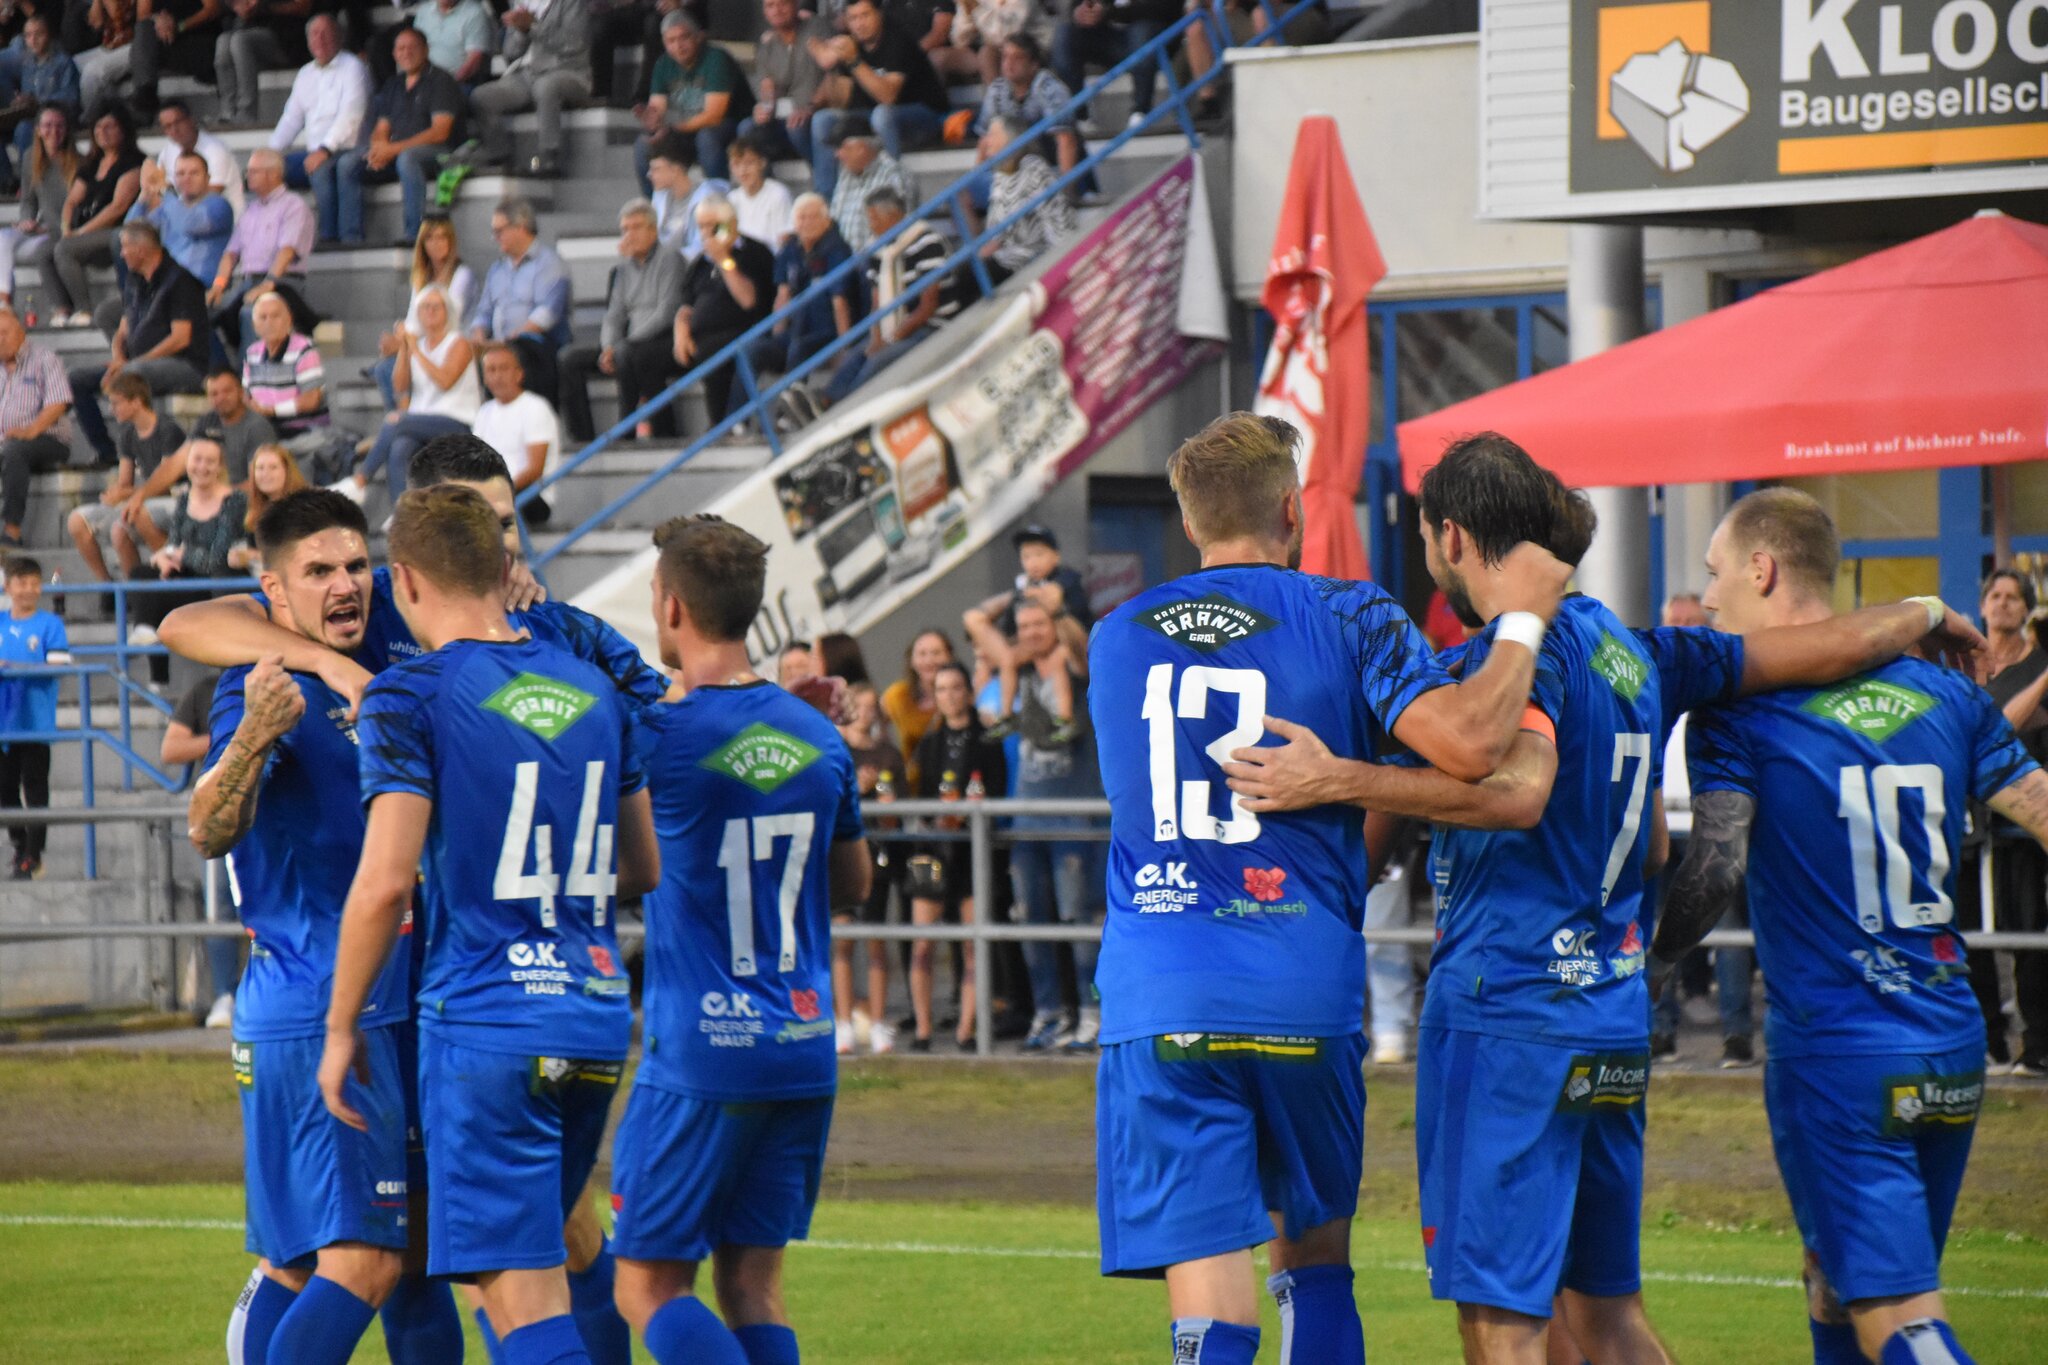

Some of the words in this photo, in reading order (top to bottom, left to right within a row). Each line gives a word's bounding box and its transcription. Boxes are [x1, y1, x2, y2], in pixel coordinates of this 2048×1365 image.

[1784, 441, 1868, 459] Braukunst
[1873, 437, 1900, 454] auf
[1904, 433, 1974, 451] höchster
[1153, 603, 1257, 627] BAUUNTERNEHMUNG
[1160, 610, 1248, 638] GRANIT
[1188, 632, 1217, 644] GRAZ
[1834, 695, 1917, 724] GRANIT
[1141, 663, 1267, 844] 13
[1601, 732, 1651, 907] 7
[493, 760, 617, 929] 44
[1837, 763, 1954, 934] 10
[1134, 862, 1198, 889] O.K.
[717, 811, 815, 977] 17
[1132, 889, 1199, 905] ENERGIE
[1138, 901, 1184, 914] HAUS
[1214, 899, 1307, 918] Almausch
[510, 969, 575, 982] ENERGIE
[1561, 972, 1596, 987] HAUS
[524, 982, 567, 996] HAUS
[699, 1019, 765, 1034] ENERGIE
[709, 1033, 756, 1047] HAUS
